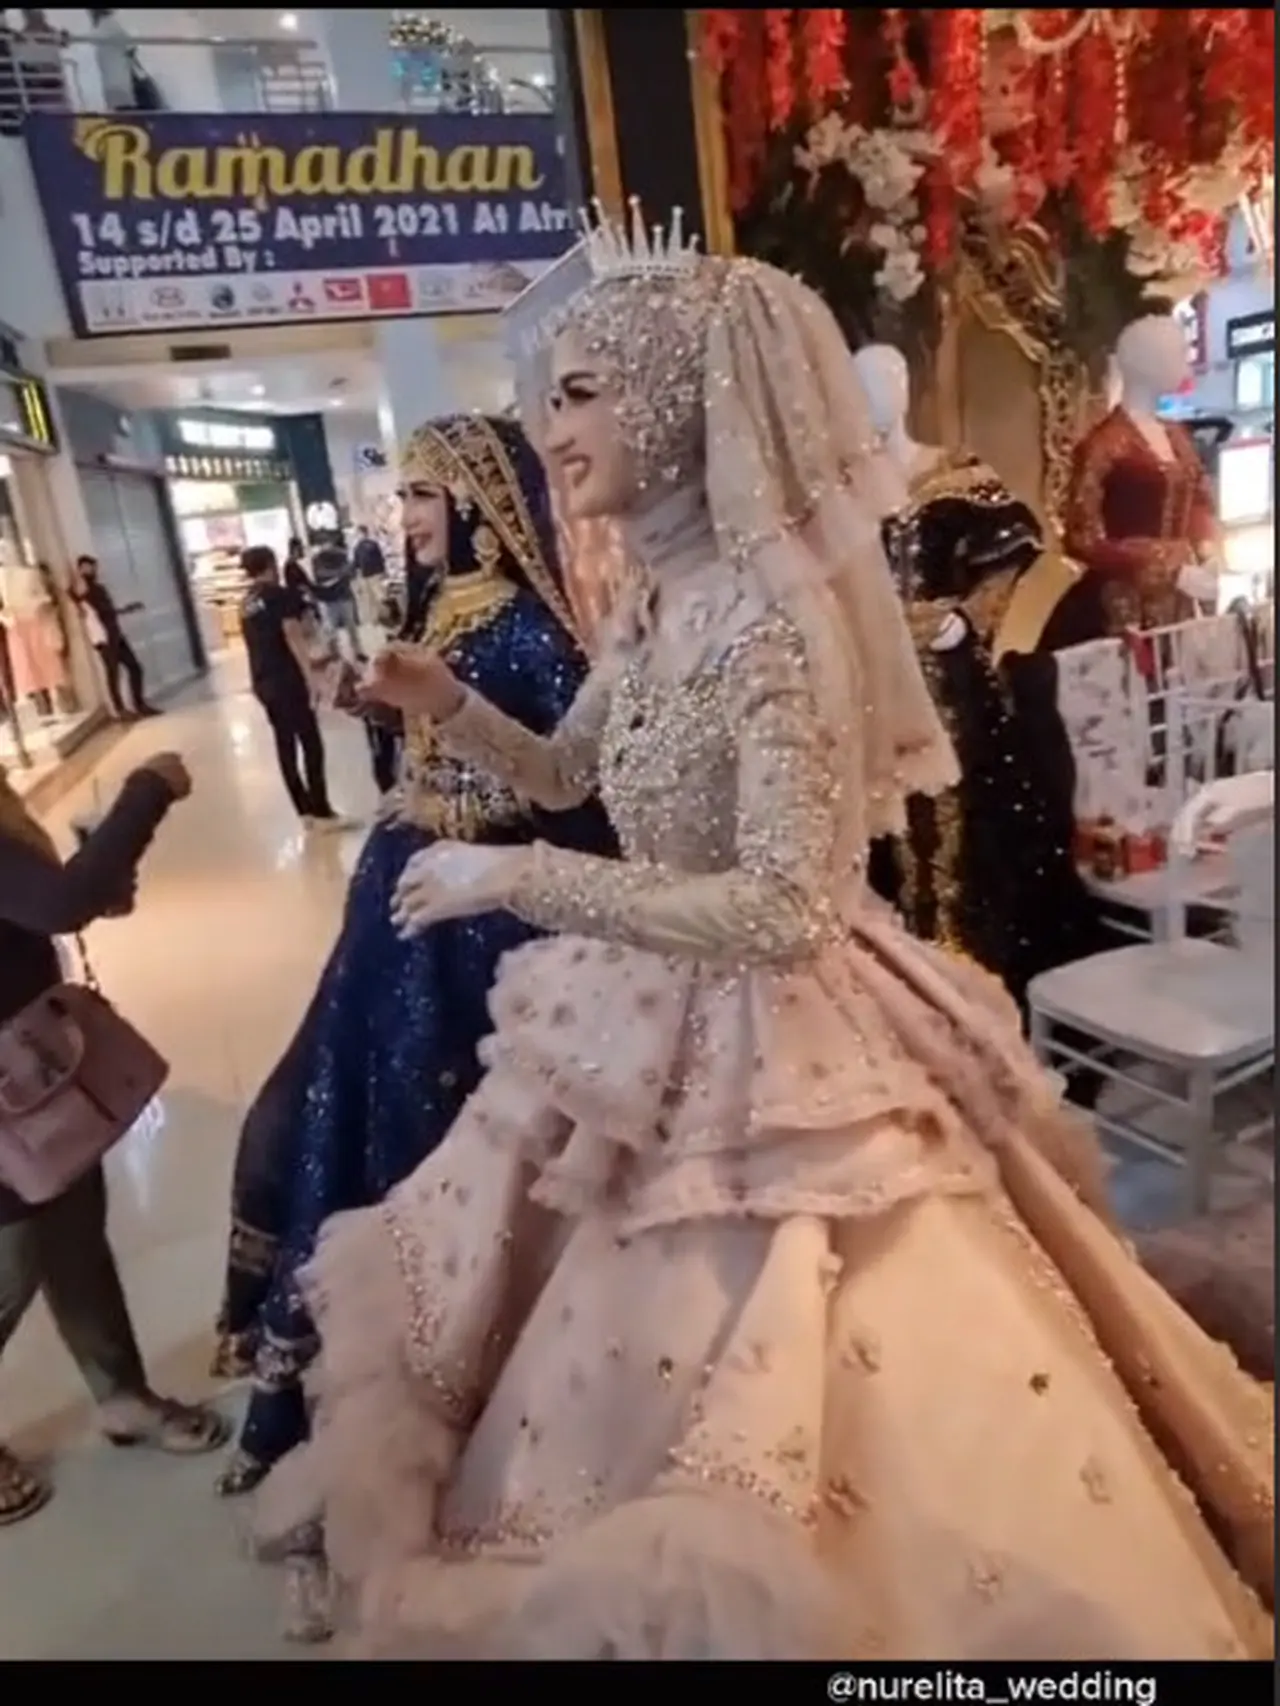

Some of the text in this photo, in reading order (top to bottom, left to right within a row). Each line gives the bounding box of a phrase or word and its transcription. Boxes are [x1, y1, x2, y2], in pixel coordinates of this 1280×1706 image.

[75, 118, 544, 200] Ramadhan
[72, 212, 126, 247] 14
[136, 208, 202, 248] s/d
[210, 209, 262, 243] 25
[275, 203, 363, 249] April
[373, 202, 459, 237] 2021
[472, 201, 510, 234] At
[78, 247, 218, 278] Supported
[223, 245, 257, 272] By
